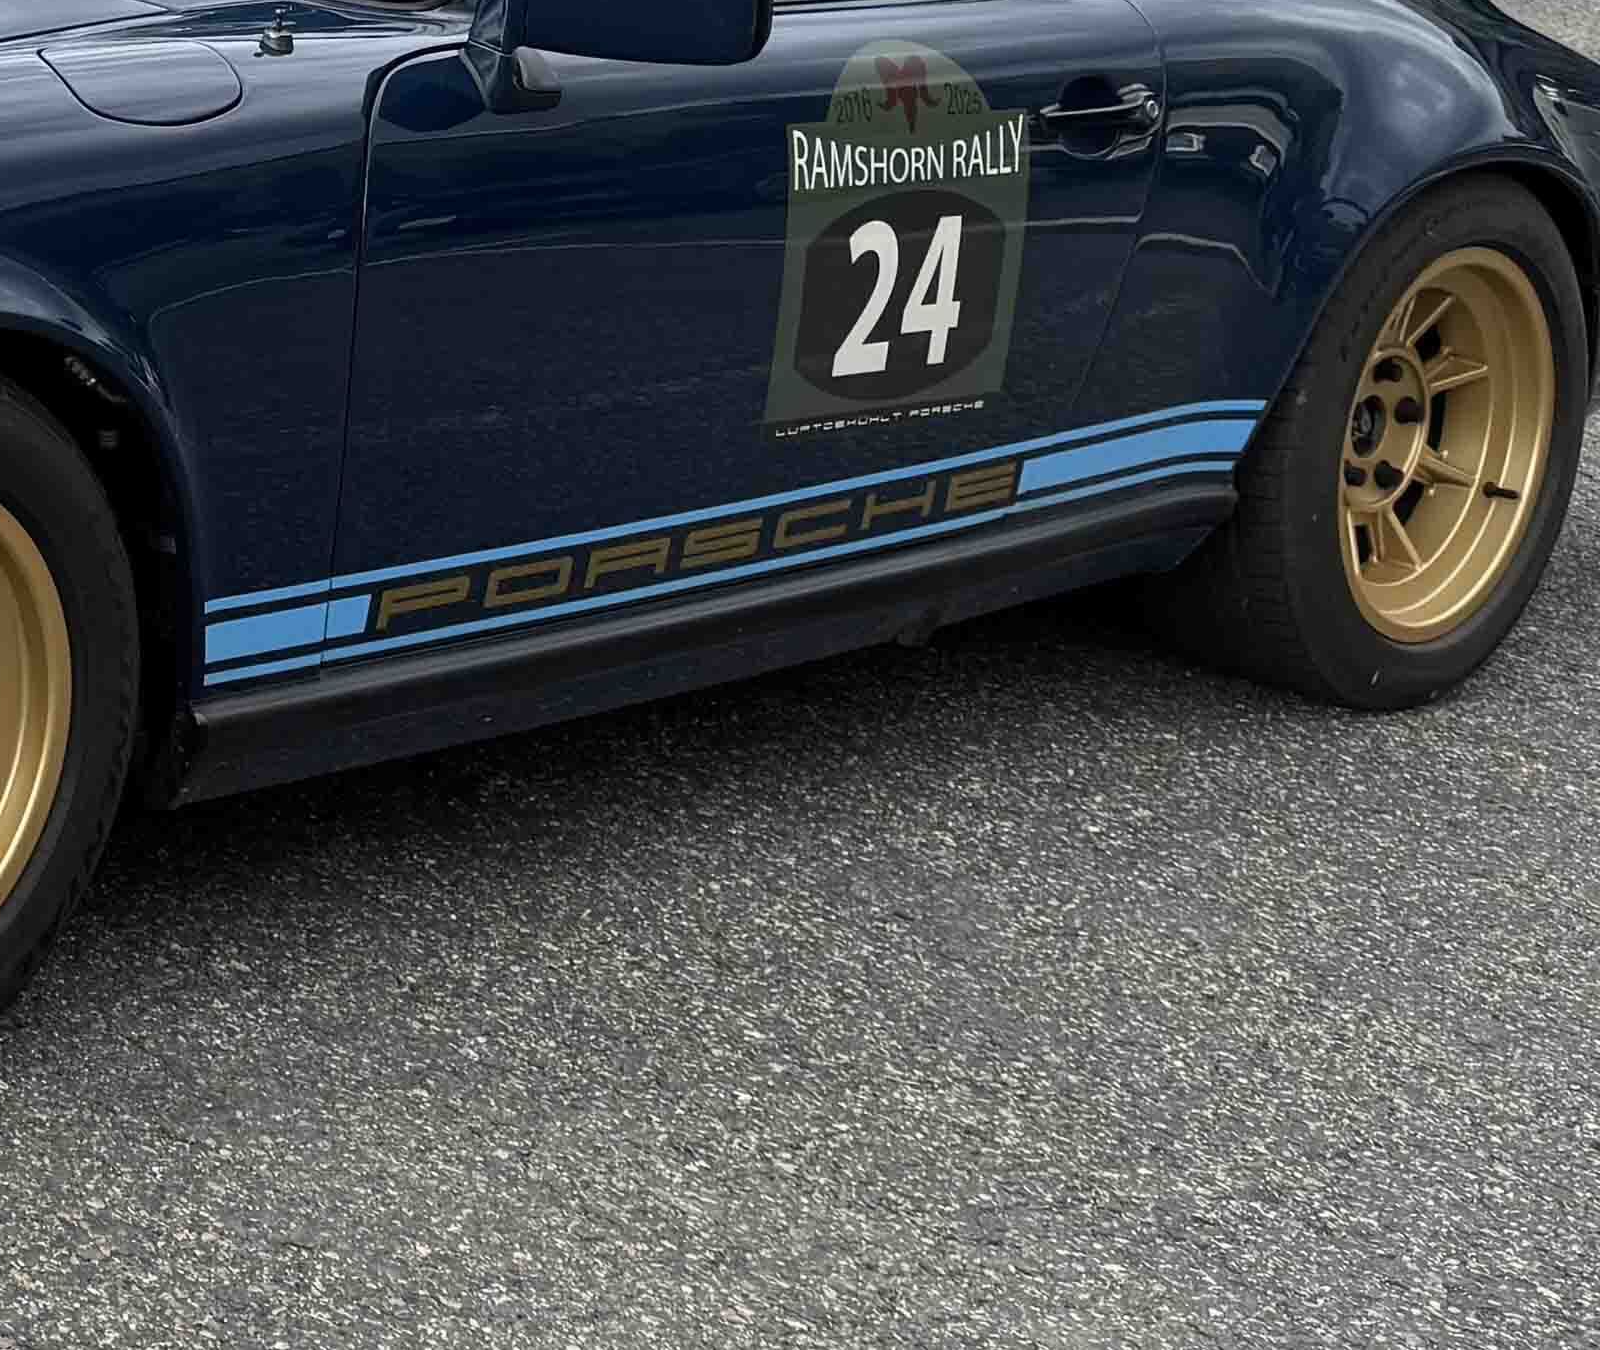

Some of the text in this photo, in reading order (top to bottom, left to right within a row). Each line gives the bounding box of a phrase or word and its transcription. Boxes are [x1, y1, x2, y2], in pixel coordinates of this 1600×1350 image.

[792, 113, 1025, 191] RAMSHORN RALLY
[831, 215, 963, 377] 24
[909, 400, 985, 418] PORSCHE
[376, 462, 1018, 633] PORSCHE
